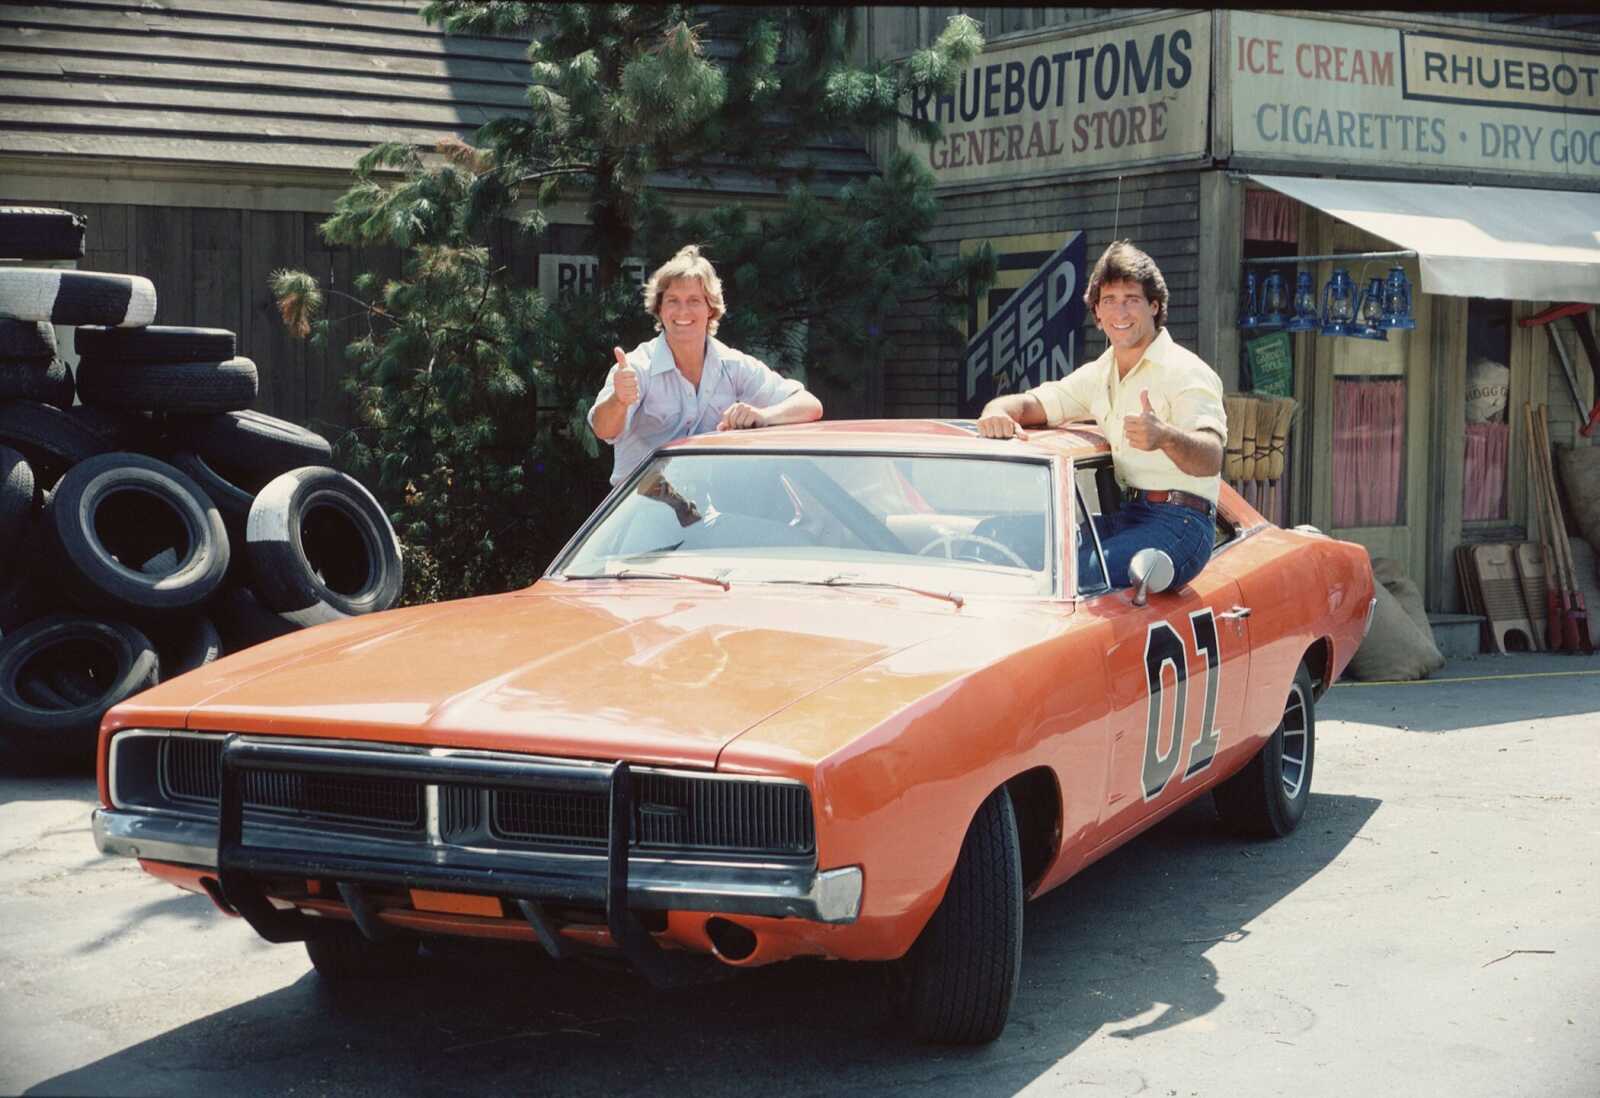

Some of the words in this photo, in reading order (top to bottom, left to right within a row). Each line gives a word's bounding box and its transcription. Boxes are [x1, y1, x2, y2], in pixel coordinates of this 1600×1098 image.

[911, 29, 1192, 124] RHUEBOTTOMS
[1237, 35, 1285, 75] ICE
[1295, 43, 1395, 87] CREAM
[1424, 51, 1600, 97] RHUEBOT
[928, 119, 1065, 170] GENERAL
[1072, 101, 1168, 153] STORE
[1256, 103, 1447, 155] CIGARETTES
[1480, 122, 1544, 161] DRY
[966, 260, 1077, 402] FEED
[996, 337, 1044, 397] AND
[1141, 606, 1221, 803] 01
